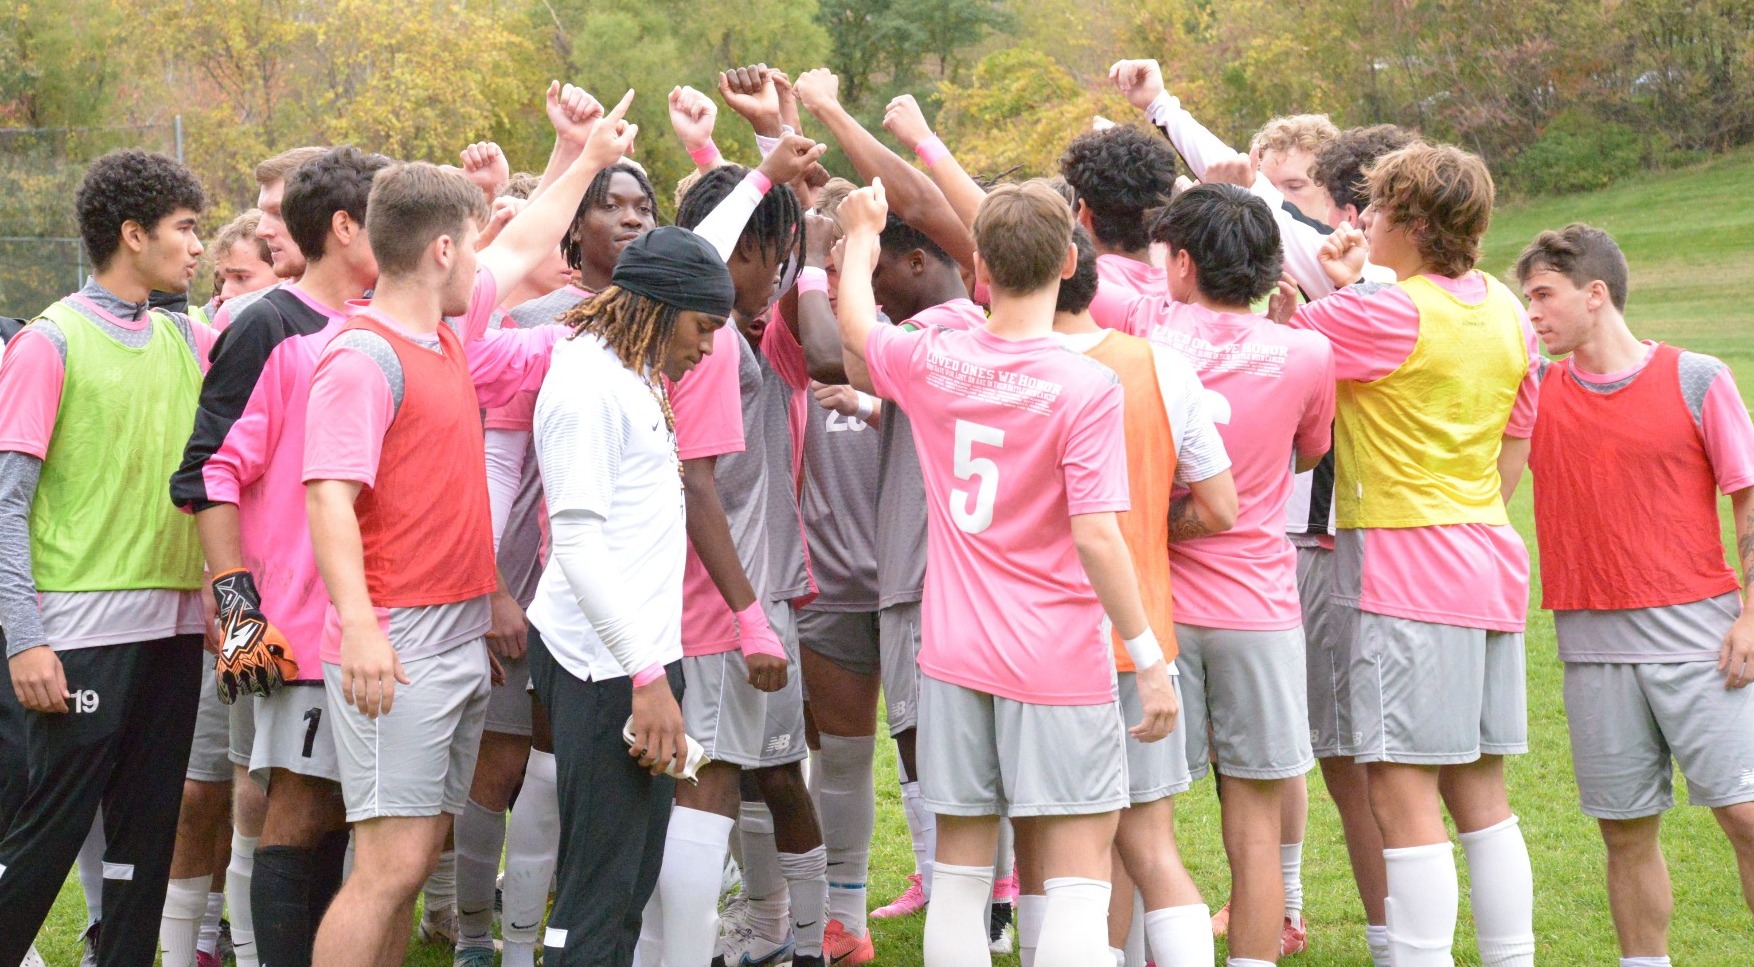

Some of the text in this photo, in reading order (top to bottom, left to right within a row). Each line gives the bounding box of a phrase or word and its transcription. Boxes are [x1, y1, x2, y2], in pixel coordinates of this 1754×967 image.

[926, 350, 960, 372] LOVED
[961, 361, 995, 381] ONES
[998, 370, 1018, 385] WE
[1018, 373, 1063, 396] HONOR
[949, 418, 1005, 534] 5
[70, 689, 100, 713] 19
[302, 706, 322, 758] 1
